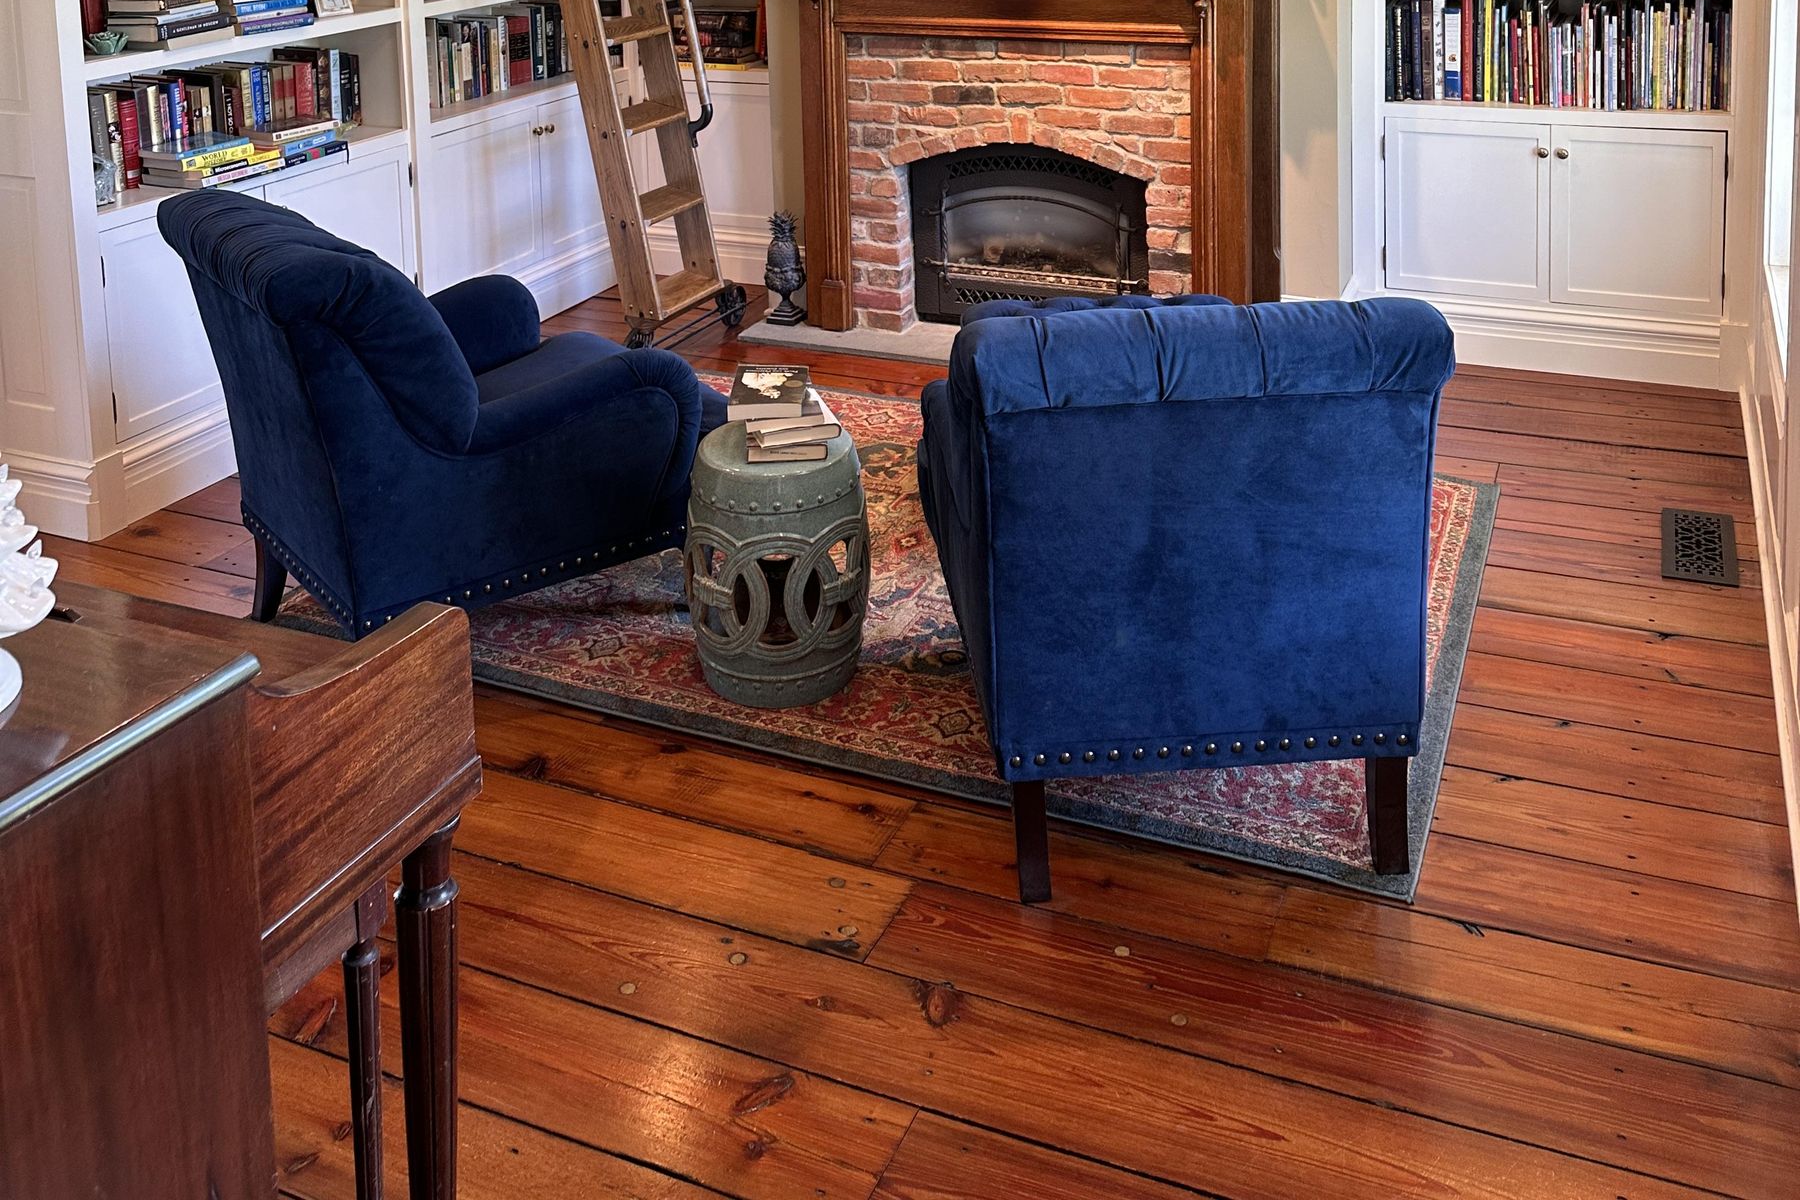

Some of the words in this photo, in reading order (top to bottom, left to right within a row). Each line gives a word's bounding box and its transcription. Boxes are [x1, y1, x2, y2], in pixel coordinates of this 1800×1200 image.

[176, 24, 197, 32] GENTLEMAN
[201, 151, 228, 161] WORLD
[214, 160, 248, 173] Microeconomics
